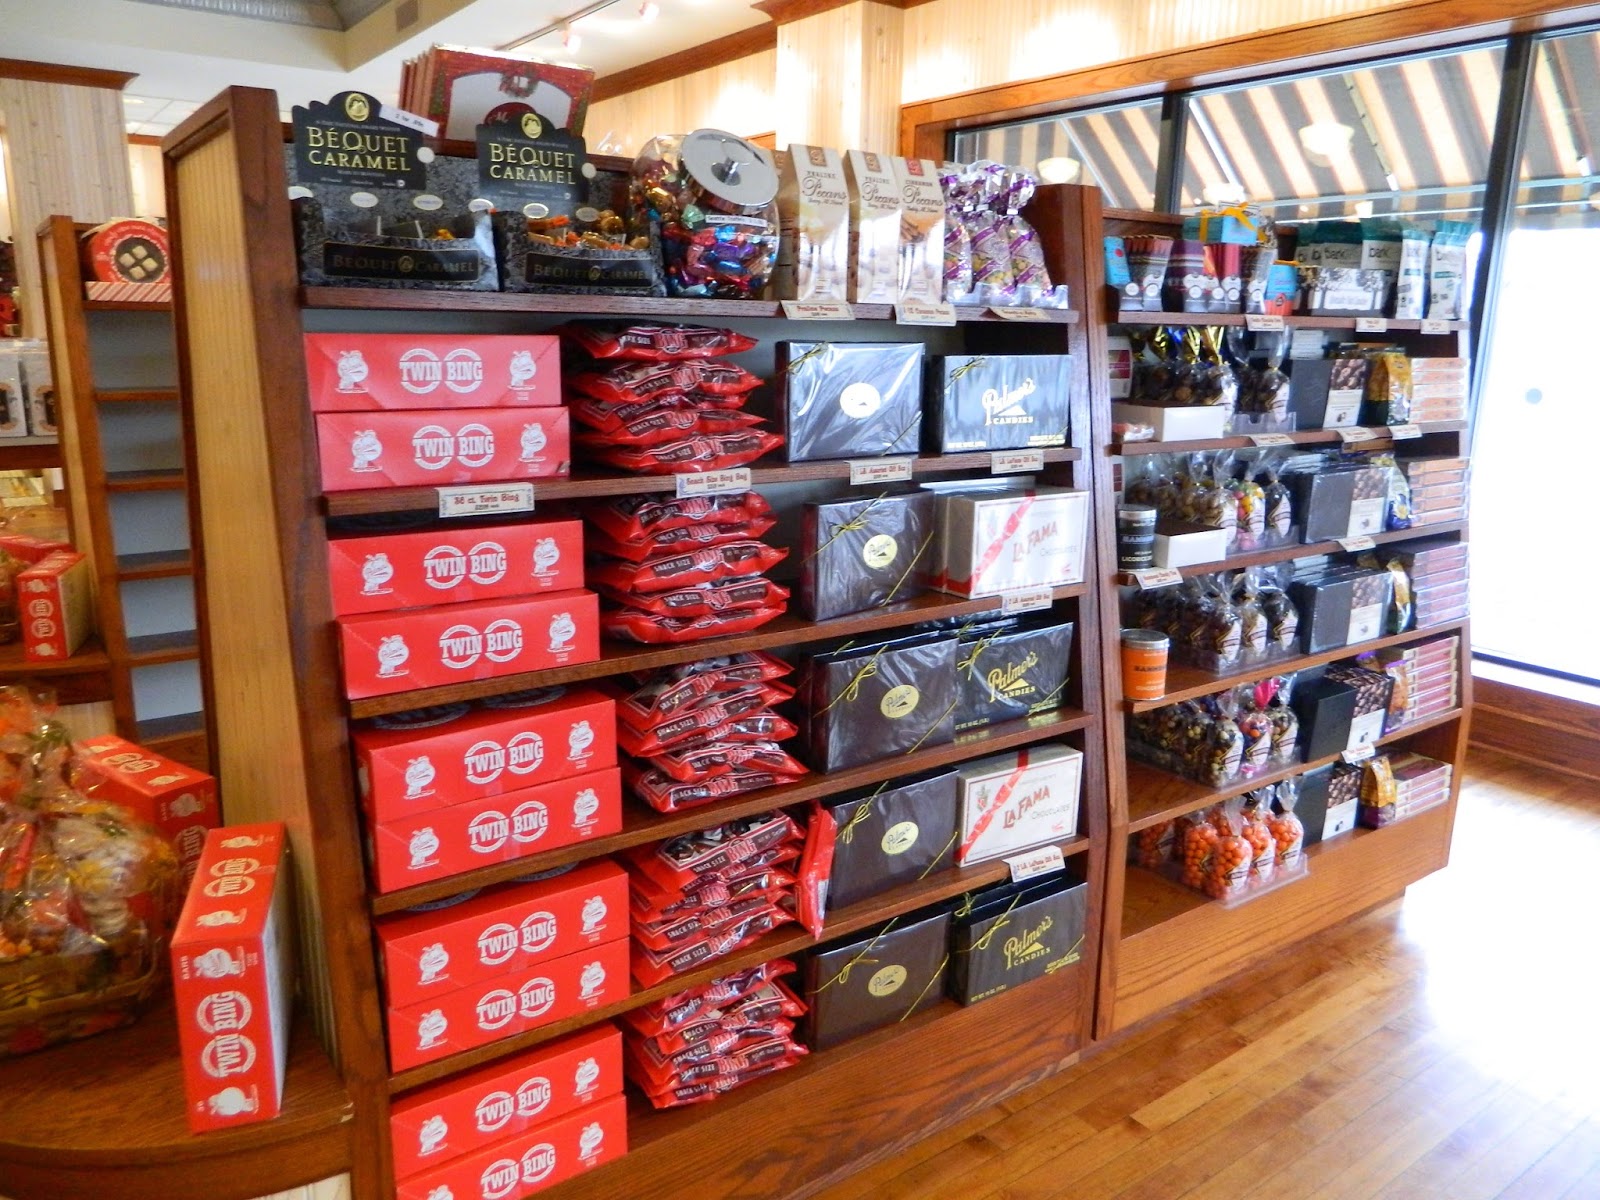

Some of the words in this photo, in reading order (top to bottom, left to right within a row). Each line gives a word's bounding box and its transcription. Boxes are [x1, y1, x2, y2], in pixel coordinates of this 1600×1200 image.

[306, 126, 410, 154] BÉQUET
[308, 150, 411, 171] CARAMEL
[489, 143, 576, 168] BÉQUET
[490, 165, 576, 185] CARAMEL
[807, 171, 836, 179] PRALINE
[802, 176, 847, 200] Pecans
[862, 182, 900, 204] Pecans
[903, 185, 944, 207] Pecans
[399, 361, 442, 381] TWIN
[447, 361, 483, 381] BING
[993, 416, 1034, 425] CANDIES
[412, 436, 454, 458] TWIN
[458, 435, 494, 456] BING
[1027, 521, 1058, 555] FAMA
[424, 556, 466, 579] TWIN
[470, 552, 507, 574] BING
[677, 558, 691, 567] SIZE
[439, 635, 482, 658] TWIN
[486, 629, 522, 652] BING
[999, 686, 1036, 699] CANDIES
[464, 748, 506, 775] TWIN
[509, 742, 543, 766] BING
[1003, 809, 1016, 829] LA
[1018, 785, 1050, 820] FAMA
[468, 819, 509, 844] TWIN
[513, 810, 548, 834] BING
[183, 828, 200, 857] BING
[726, 838, 757, 863] BING
[223, 857, 247, 875] BING
[216, 876, 244, 896] TWIN
[478, 931, 519, 958] TWIN
[522, 919, 557, 945] BING
[1004, 916, 1053, 970] Palmer's
[671, 954, 691, 968] SNACK
[692, 945, 709, 958] SIZE
[1014, 947, 1051, 966] CANDIES
[211, 990, 239, 1031] BING
[476, 996, 516, 1023] TWIN
[520, 985, 555, 1009] BING
[214, 1033, 242, 1077] TWIN
[718, 1053, 750, 1075] BING
[475, 1096, 514, 1125] TWIN
[518, 1083, 551, 1110] BING
[481, 1164, 519, 1192] TWIN
[523, 1150, 556, 1176] BING
